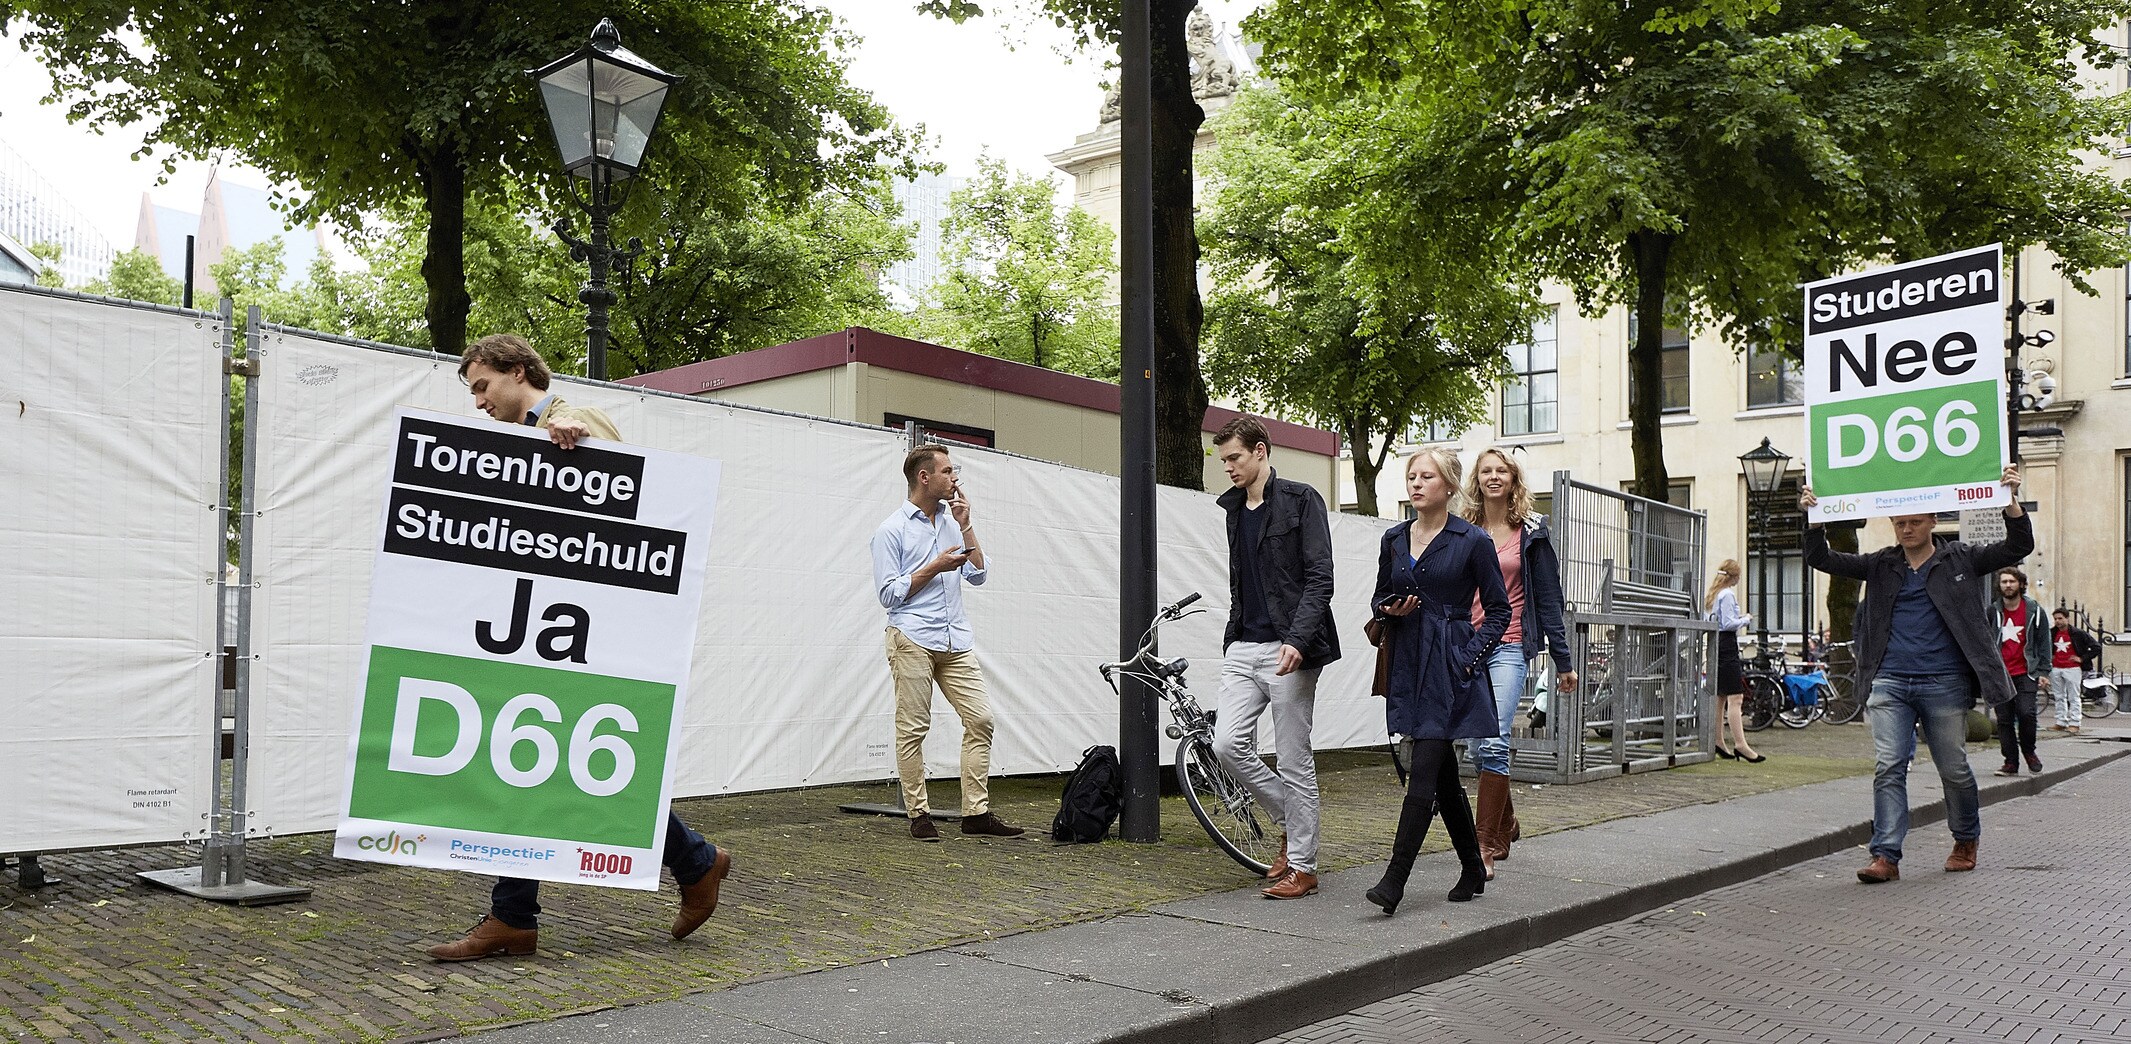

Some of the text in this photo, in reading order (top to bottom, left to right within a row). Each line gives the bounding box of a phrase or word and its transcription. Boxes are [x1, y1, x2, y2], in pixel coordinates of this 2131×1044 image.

[1813, 267, 1993, 323] Studeren
[1829, 331, 1977, 393] Nee
[1827, 400, 1980, 469] D66
[407, 432, 635, 504] Torenhoge
[1875, 492, 1941, 505] PerspectieF
[1958, 487, 1993, 500] ROOD
[396, 504, 675, 577] Studieschuld
[474, 578, 591, 664] Ja
[387, 676, 640, 796] D66
[451, 839, 556, 861] PerspectieF
[580, 851, 633, 875] ROOD
